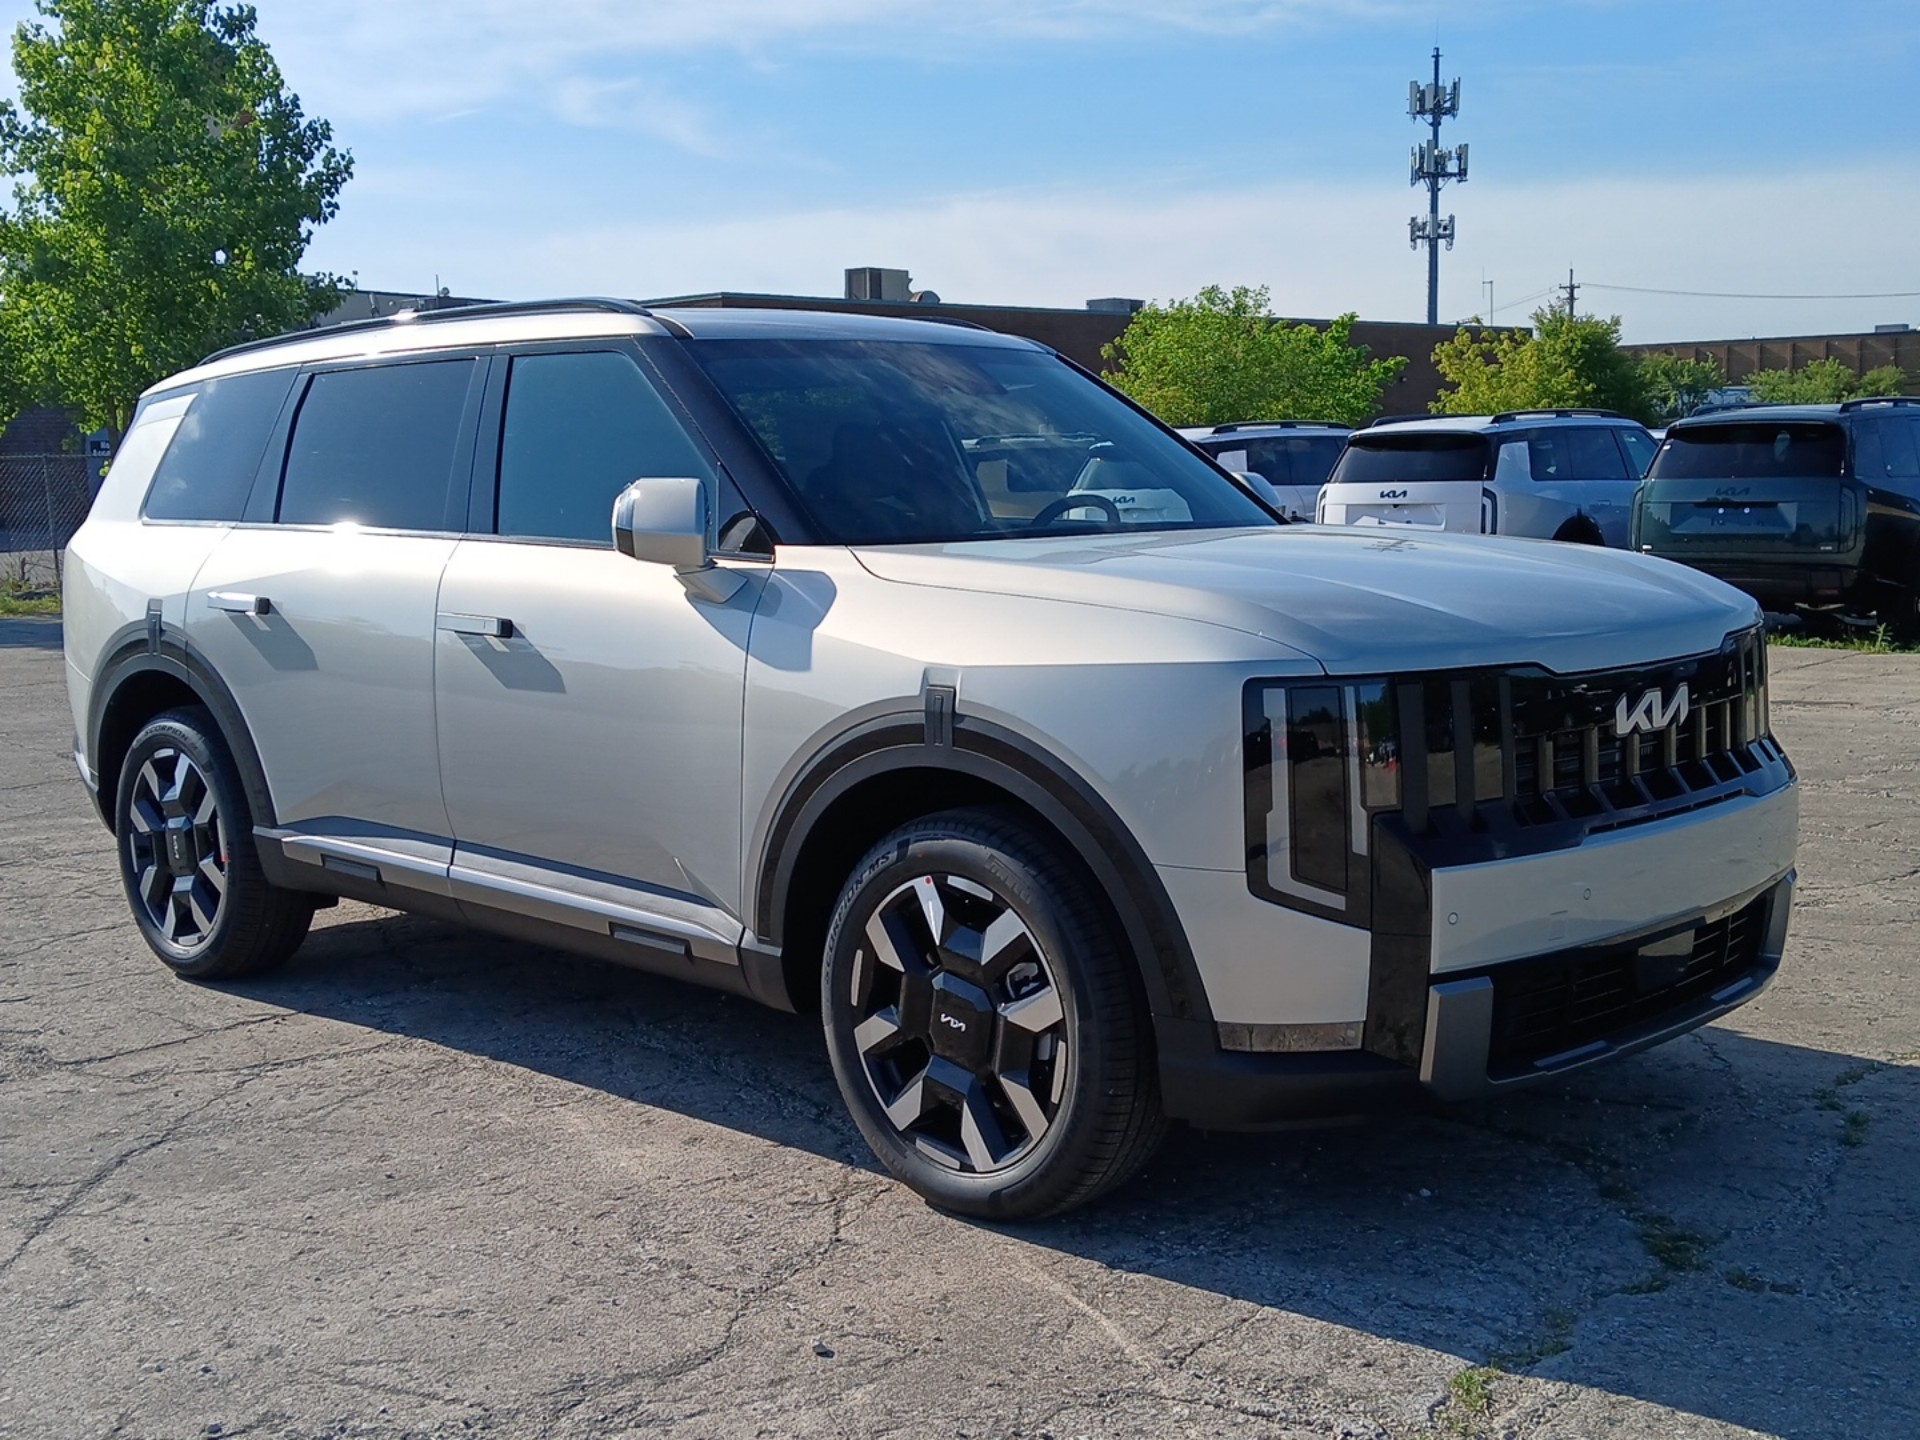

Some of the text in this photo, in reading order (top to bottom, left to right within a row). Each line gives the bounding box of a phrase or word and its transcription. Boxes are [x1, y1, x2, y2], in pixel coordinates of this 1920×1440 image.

[1380, 490, 1408, 499] KIA
[1615, 682, 1689, 738] KIA
[143, 725, 189, 741] SCORPION
[824, 869, 868, 985] SCORPION
